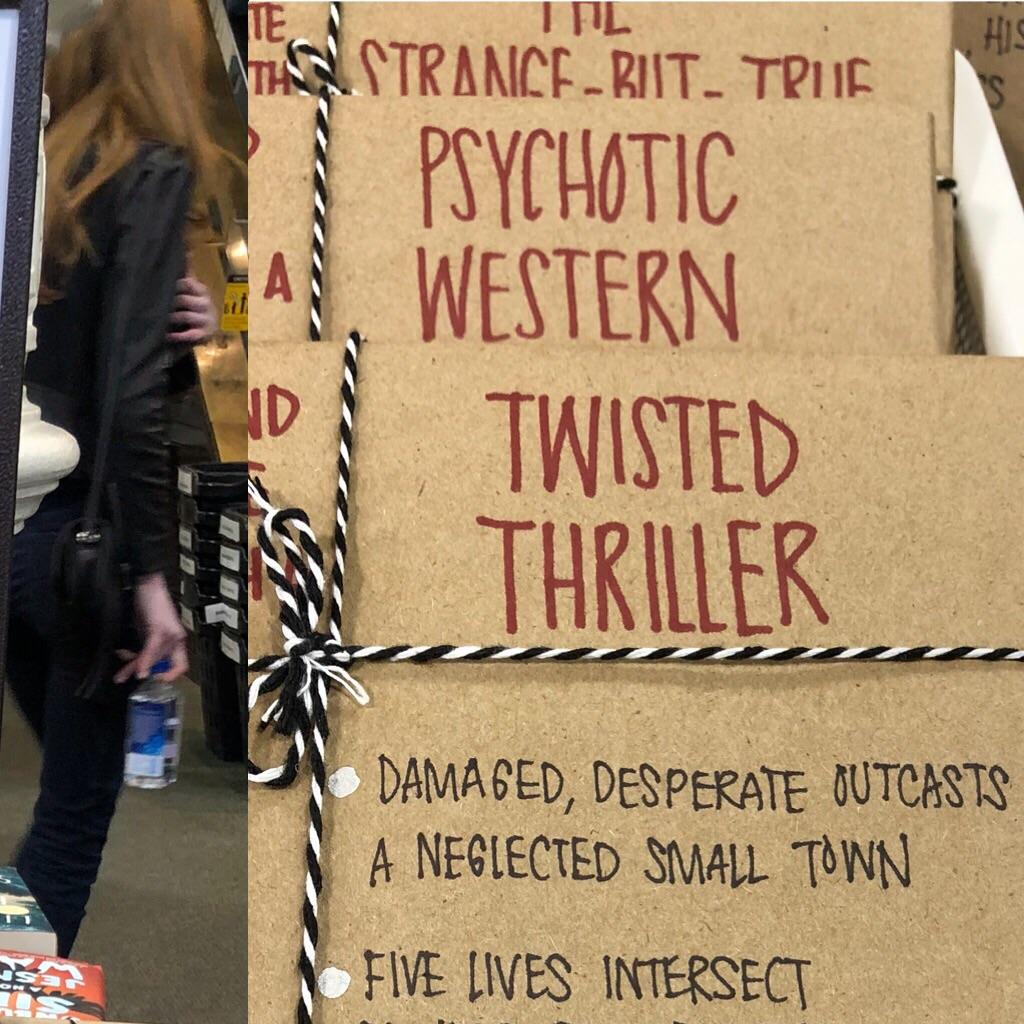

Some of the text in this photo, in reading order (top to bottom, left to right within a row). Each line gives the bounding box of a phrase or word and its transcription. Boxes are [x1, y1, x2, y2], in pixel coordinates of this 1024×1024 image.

[421, 126, 738, 229] PSYCHOTIC
[417, 245, 739, 347] WESTERN
[486, 392, 799, 498] TWISTED
[476, 516, 829, 637] THRILLER
[378, 754, 1009, 815] DAMAGED, DESPERATE OUTCASTS
[417, 832, 911, 890] NEGLECTED SMALL TOWN
[364, 949, 811, 1011] FIVE LIVES INTERSECT
